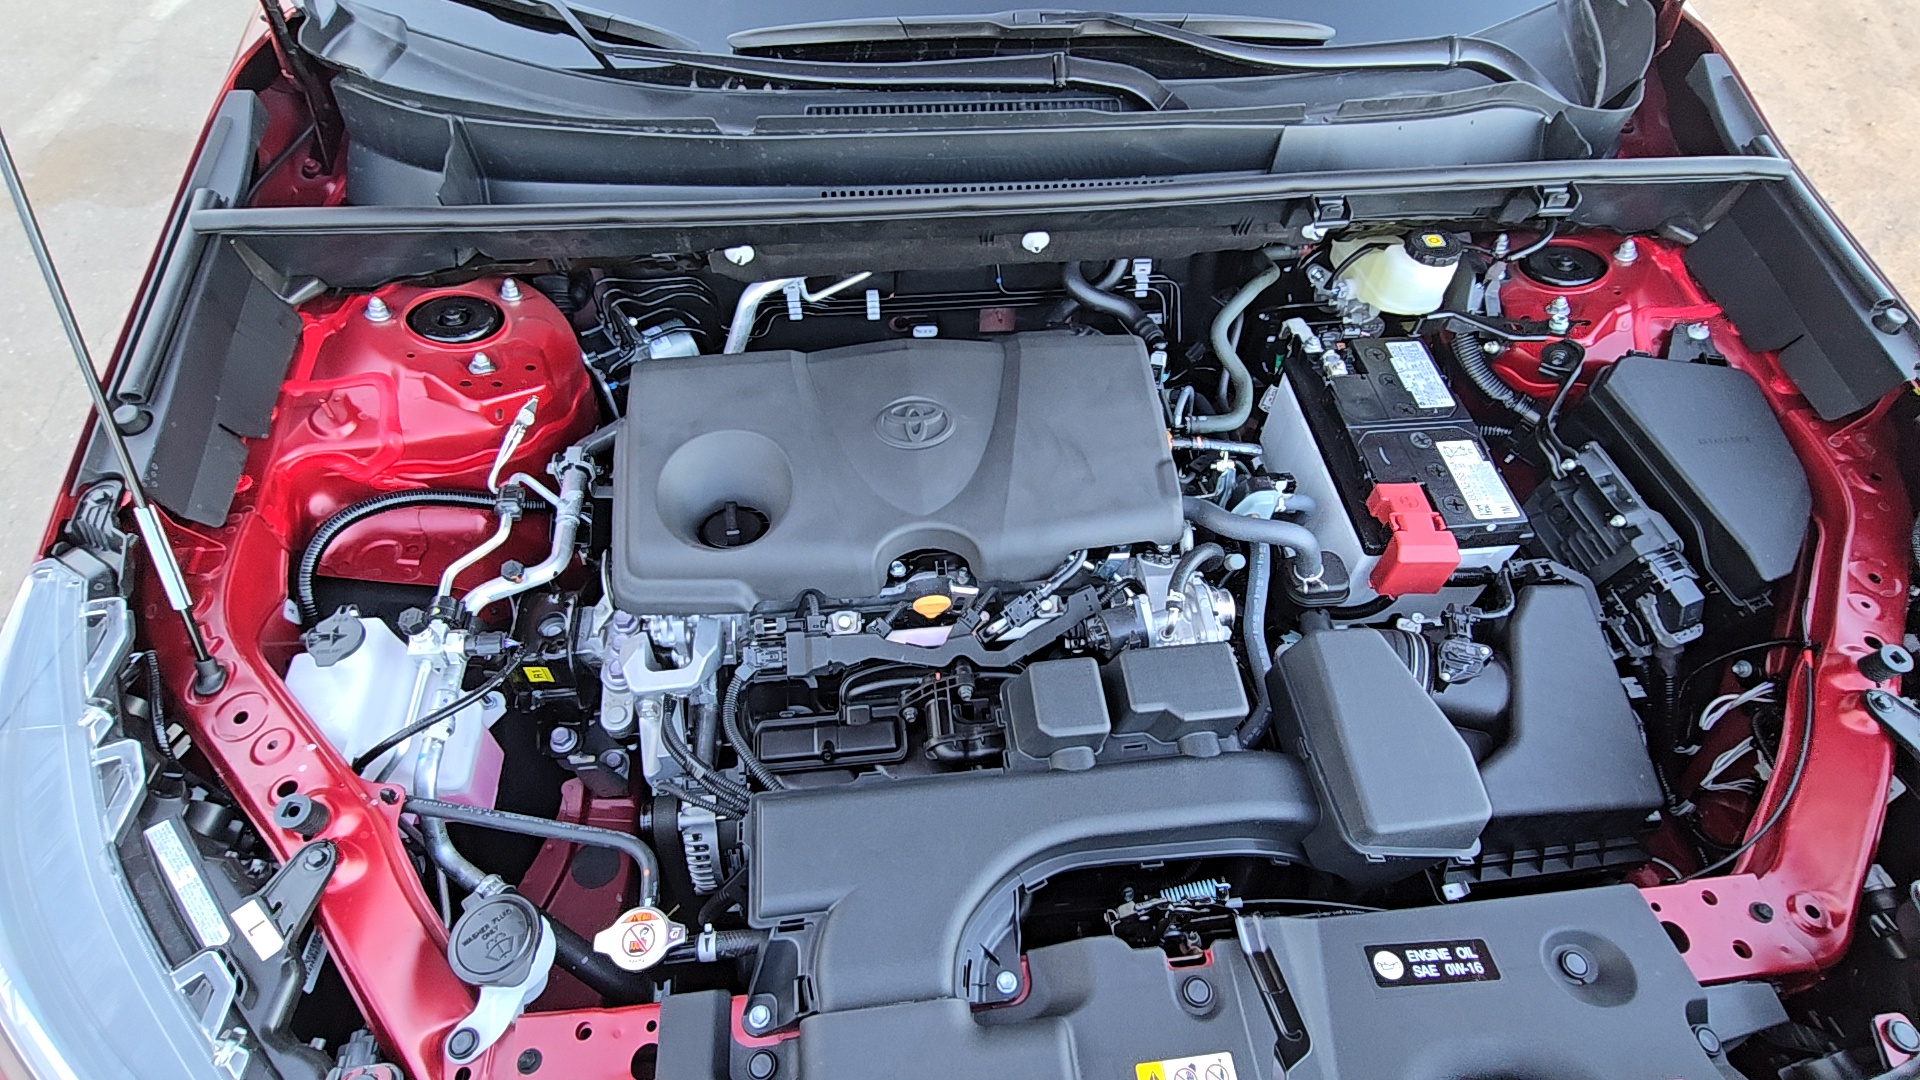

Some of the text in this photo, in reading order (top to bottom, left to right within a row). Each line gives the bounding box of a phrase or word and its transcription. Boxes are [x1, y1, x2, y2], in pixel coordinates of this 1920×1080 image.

[462, 909, 512, 946] WASHER FLUID
[482, 925, 498, 940] ONLY
[1405, 947, 1479, 962] ENGINE OIL
[1412, 962, 1485, 978] SAE 0W-16
